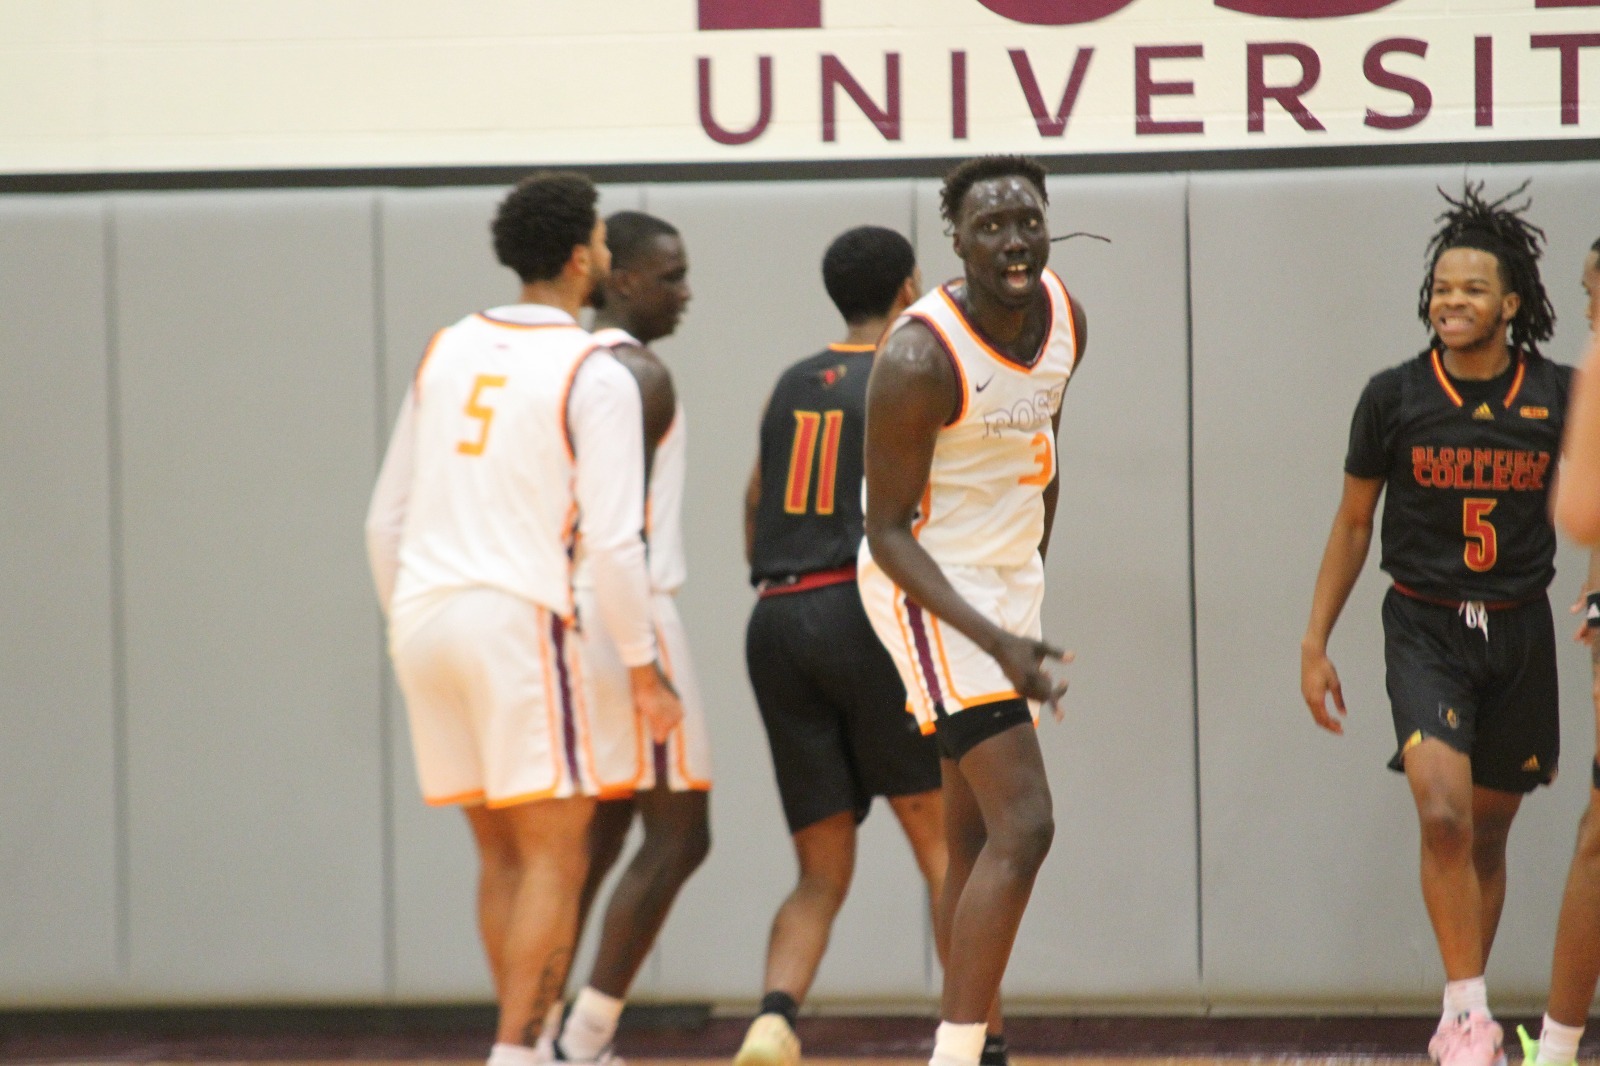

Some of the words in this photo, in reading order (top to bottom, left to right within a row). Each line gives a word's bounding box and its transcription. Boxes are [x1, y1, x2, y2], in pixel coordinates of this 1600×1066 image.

[697, 33, 1600, 146] UNIVERSIT
[456, 374, 507, 456] 5
[784, 410, 844, 515] 11
[1018, 432, 1053, 490] 3
[1463, 498, 1498, 573] 5
